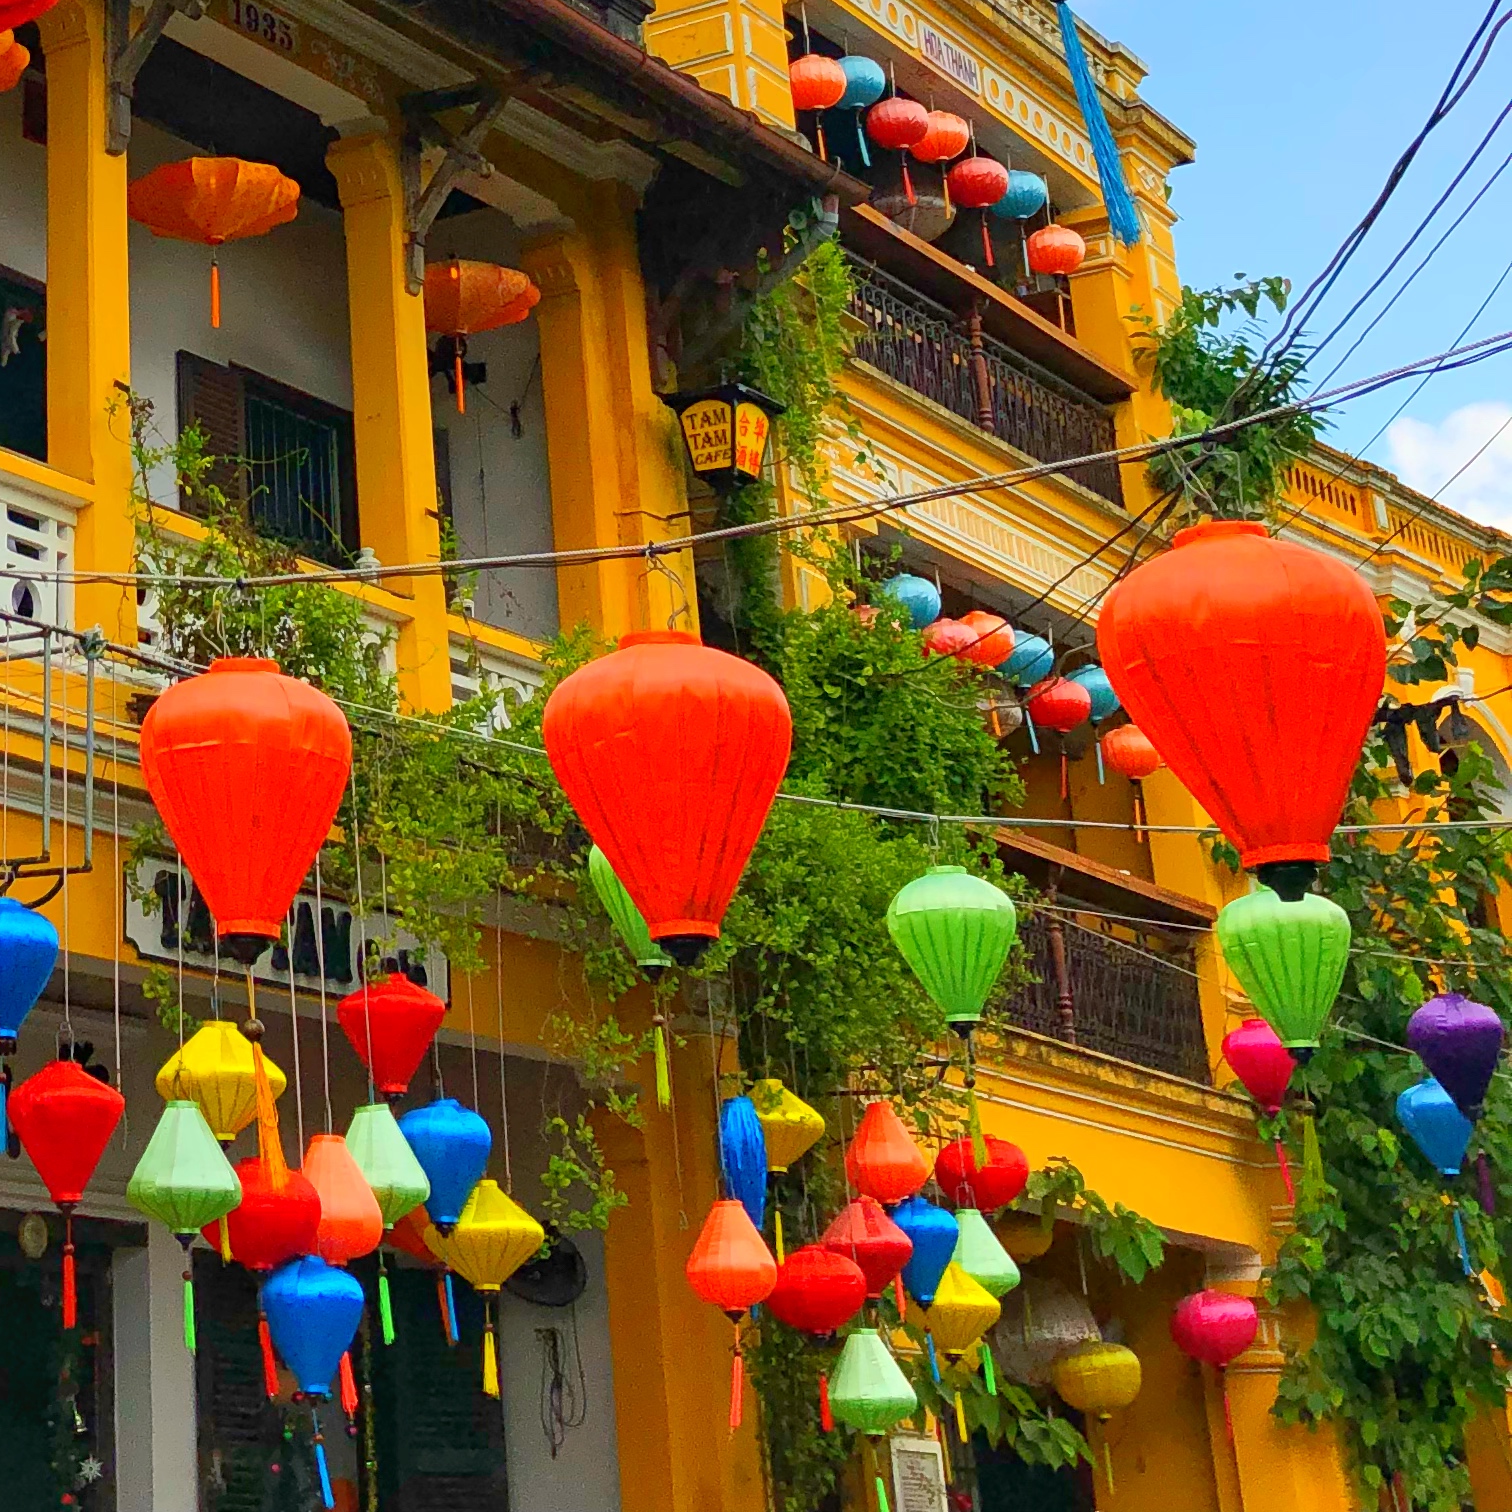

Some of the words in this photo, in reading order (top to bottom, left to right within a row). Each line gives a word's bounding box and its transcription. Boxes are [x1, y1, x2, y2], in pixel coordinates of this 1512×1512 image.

[686, 407, 729, 430] TAM
[689, 429, 729, 450] TAM
[695, 449, 731, 465] CAFE
